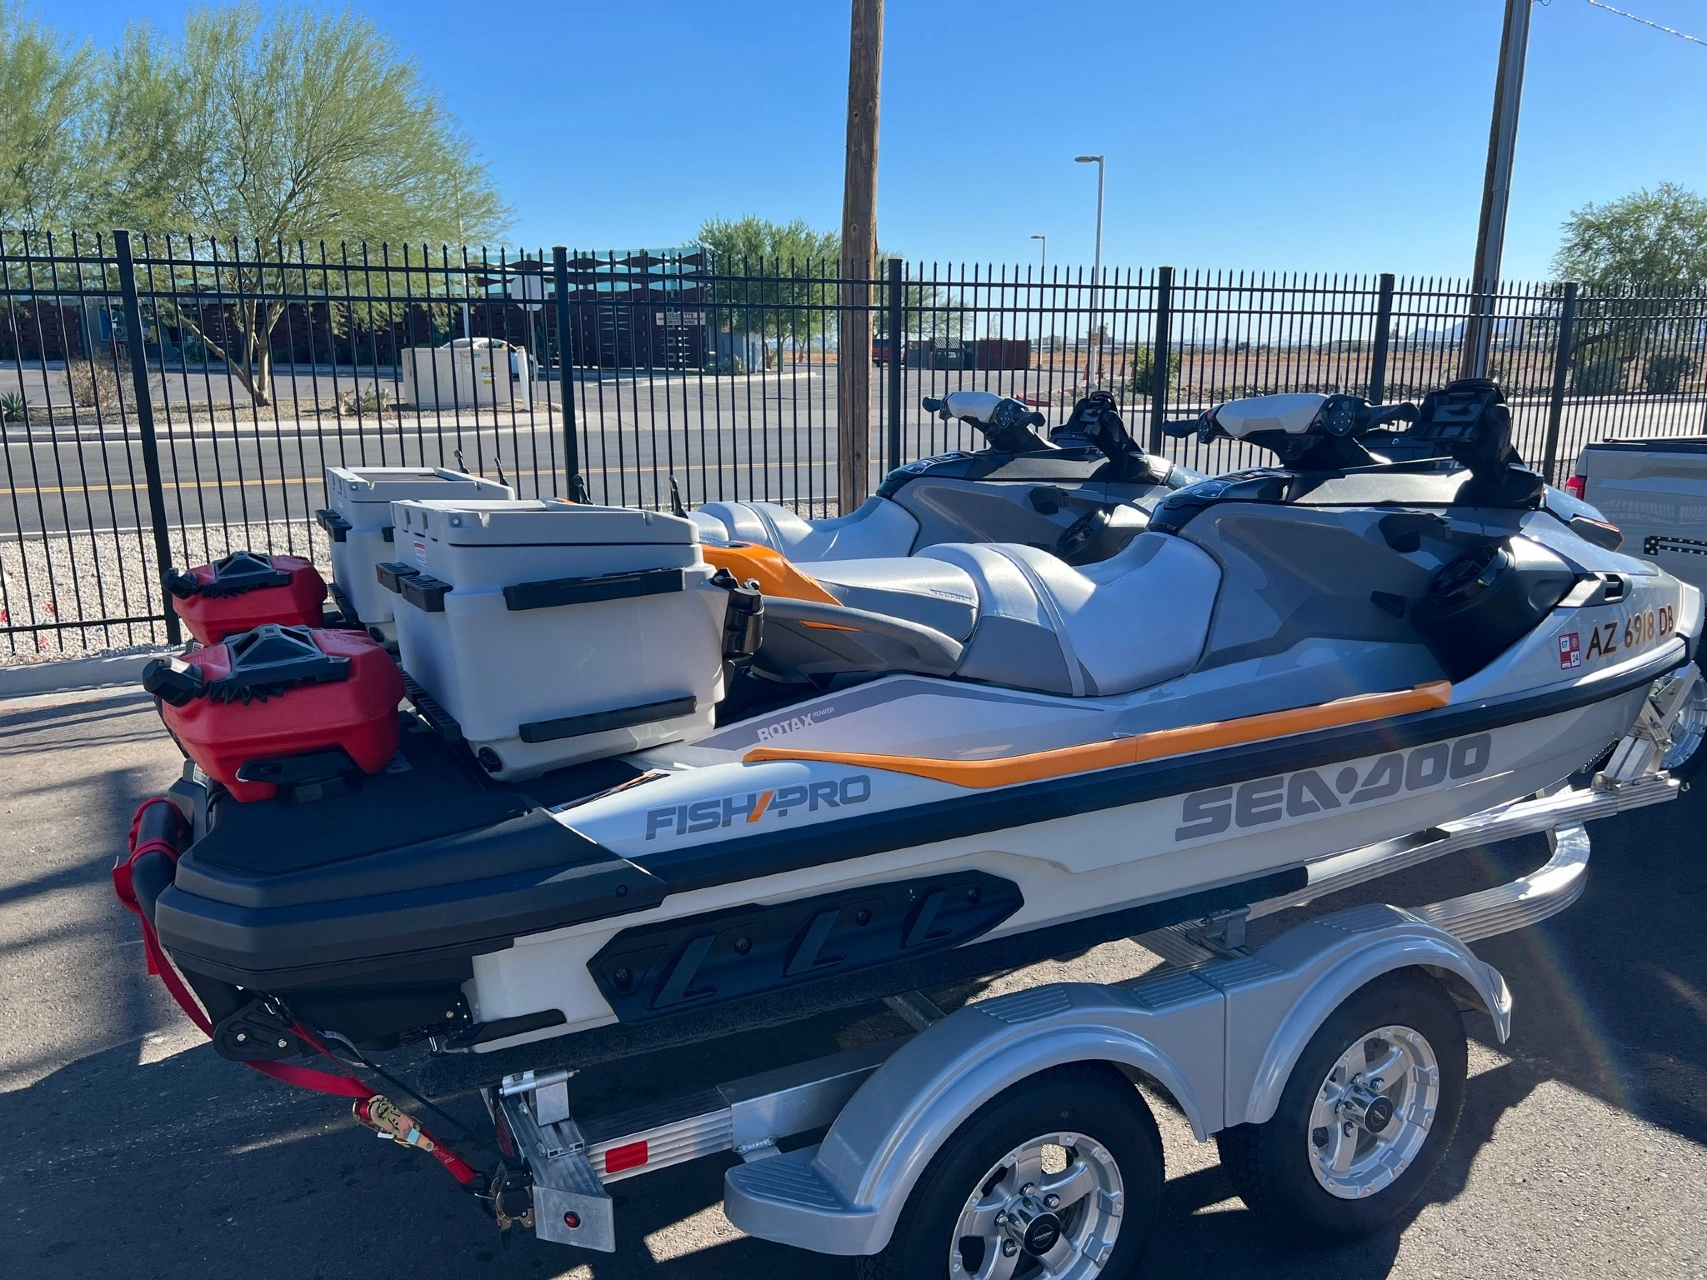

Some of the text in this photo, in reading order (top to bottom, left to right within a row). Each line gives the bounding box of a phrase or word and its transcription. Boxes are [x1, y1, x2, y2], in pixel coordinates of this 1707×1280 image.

[1585, 604, 1674, 660] AZ 6918 DB
[756, 706, 835, 743] ROTAX POWER
